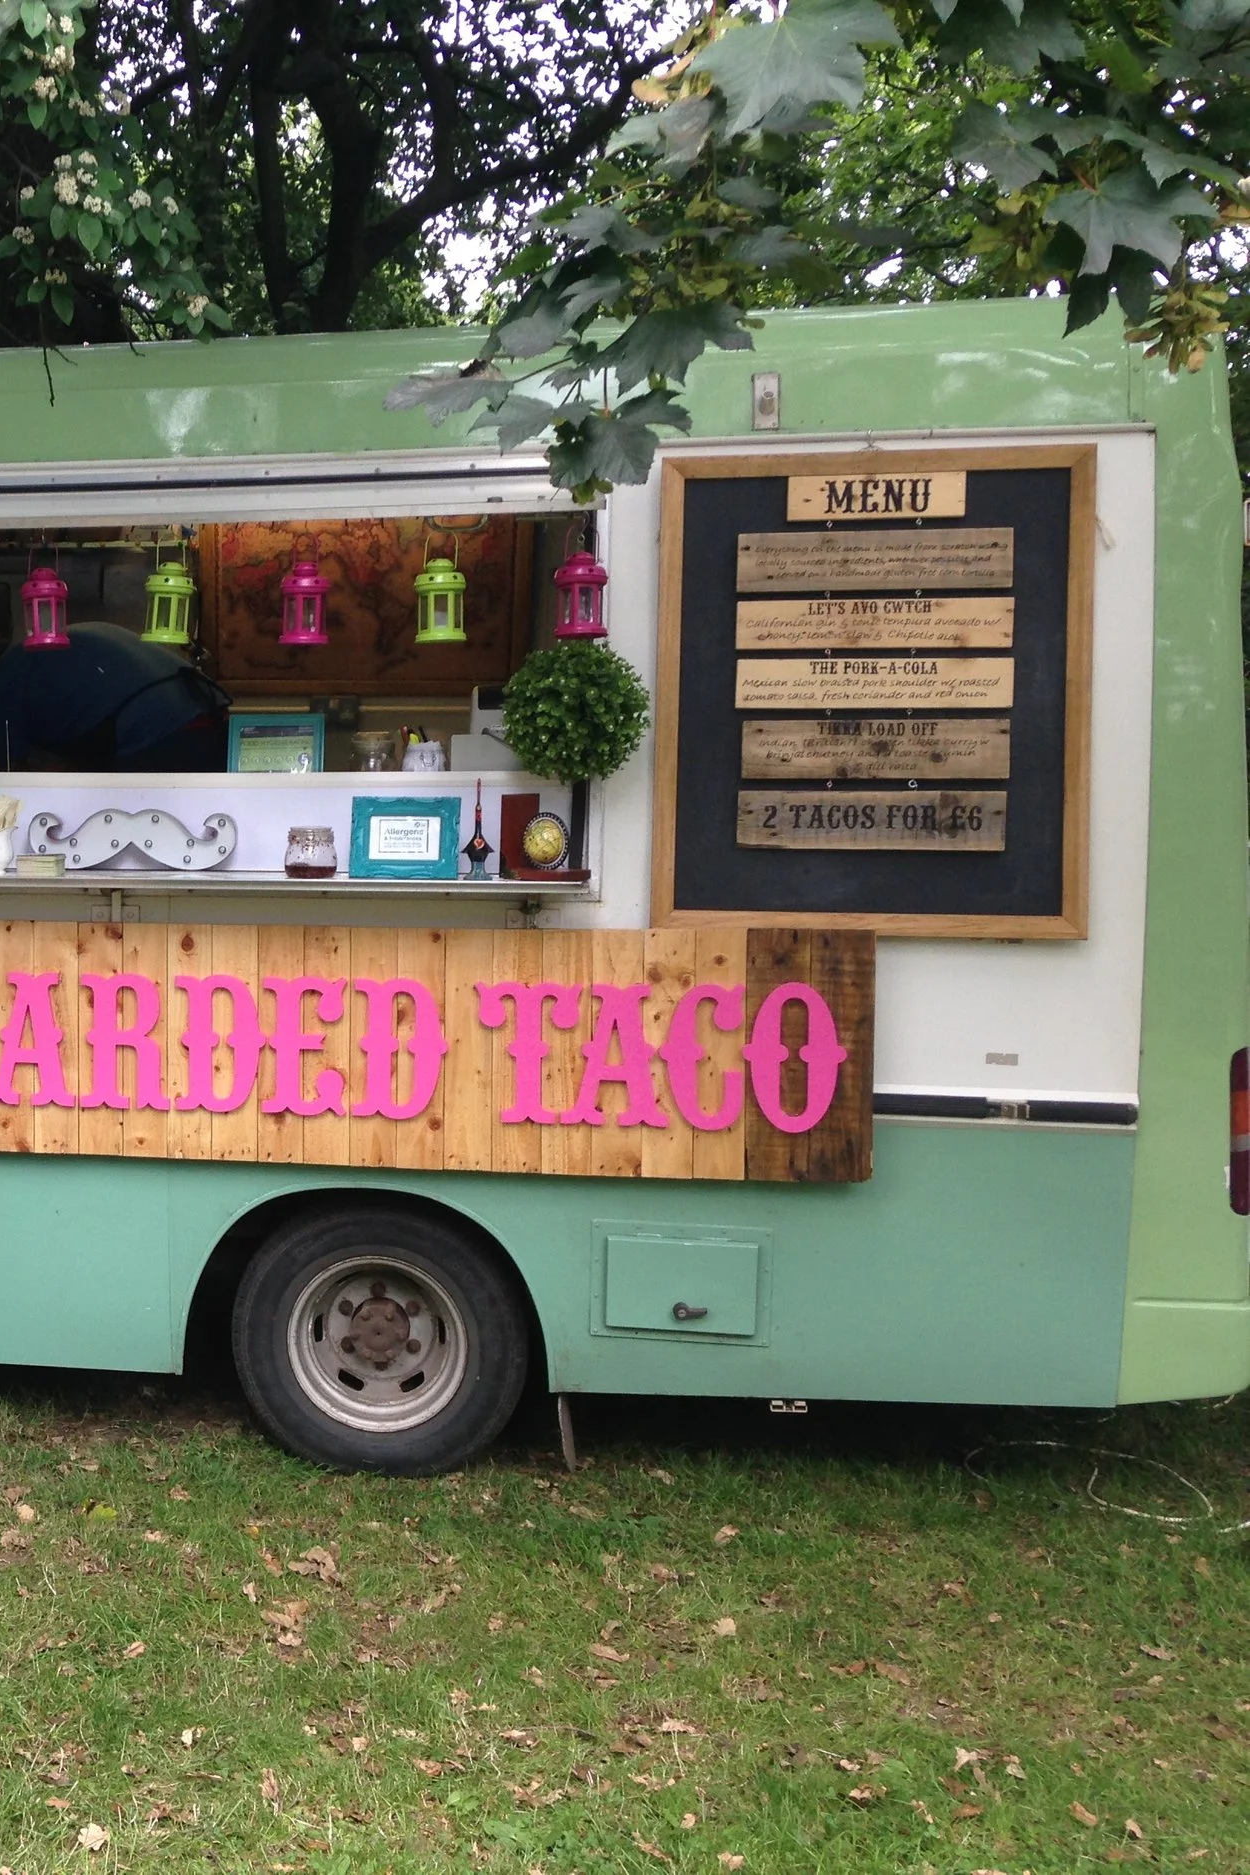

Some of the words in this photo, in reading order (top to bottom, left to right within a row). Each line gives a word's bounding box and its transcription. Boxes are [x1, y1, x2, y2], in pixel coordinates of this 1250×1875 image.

[824, 478, 932, 514] MENU
[885, 543, 912, 551] made
[914, 541, 937, 553] from
[972, 554, 992, 562] and
[918, 567, 937, 577] free
[809, 601, 846, 616] LET'S
[851, 600, 878, 615] AVO
[883, 600, 932, 614] CWTCH
[746, 617, 812, 628] Californian
[816, 619, 836, 629] gin
[883, 616, 931, 627] tempura
[934, 616, 981, 626] avocado
[810, 661, 838, 675] THE
[843, 660, 938, 675] PORK-A-COLA
[742, 679, 788, 688] Mexican
[792, 678, 818, 687] slow
[862, 677, 885, 689] pork
[890, 678, 936, 687] shoulder
[958, 677, 1001, 687] roasted
[821, 690, 850, 703] fresh
[852, 690, 905, 699] coriander
[908, 690, 931, 699] and
[935, 688, 953, 697] red
[955, 690, 988, 698] onion
[867, 722, 905, 736] LOAD
[911, 721, 938, 736] OFF
[301, 753, 309, 765] 5
[762, 805, 778, 830] 2
[789, 804, 876, 830] TACOS
[885, 804, 940, 831] FOR
[950, 805, 984, 831] £6
[383, 827, 425, 836] Allergens
[473, 980, 848, 1134] TACO
